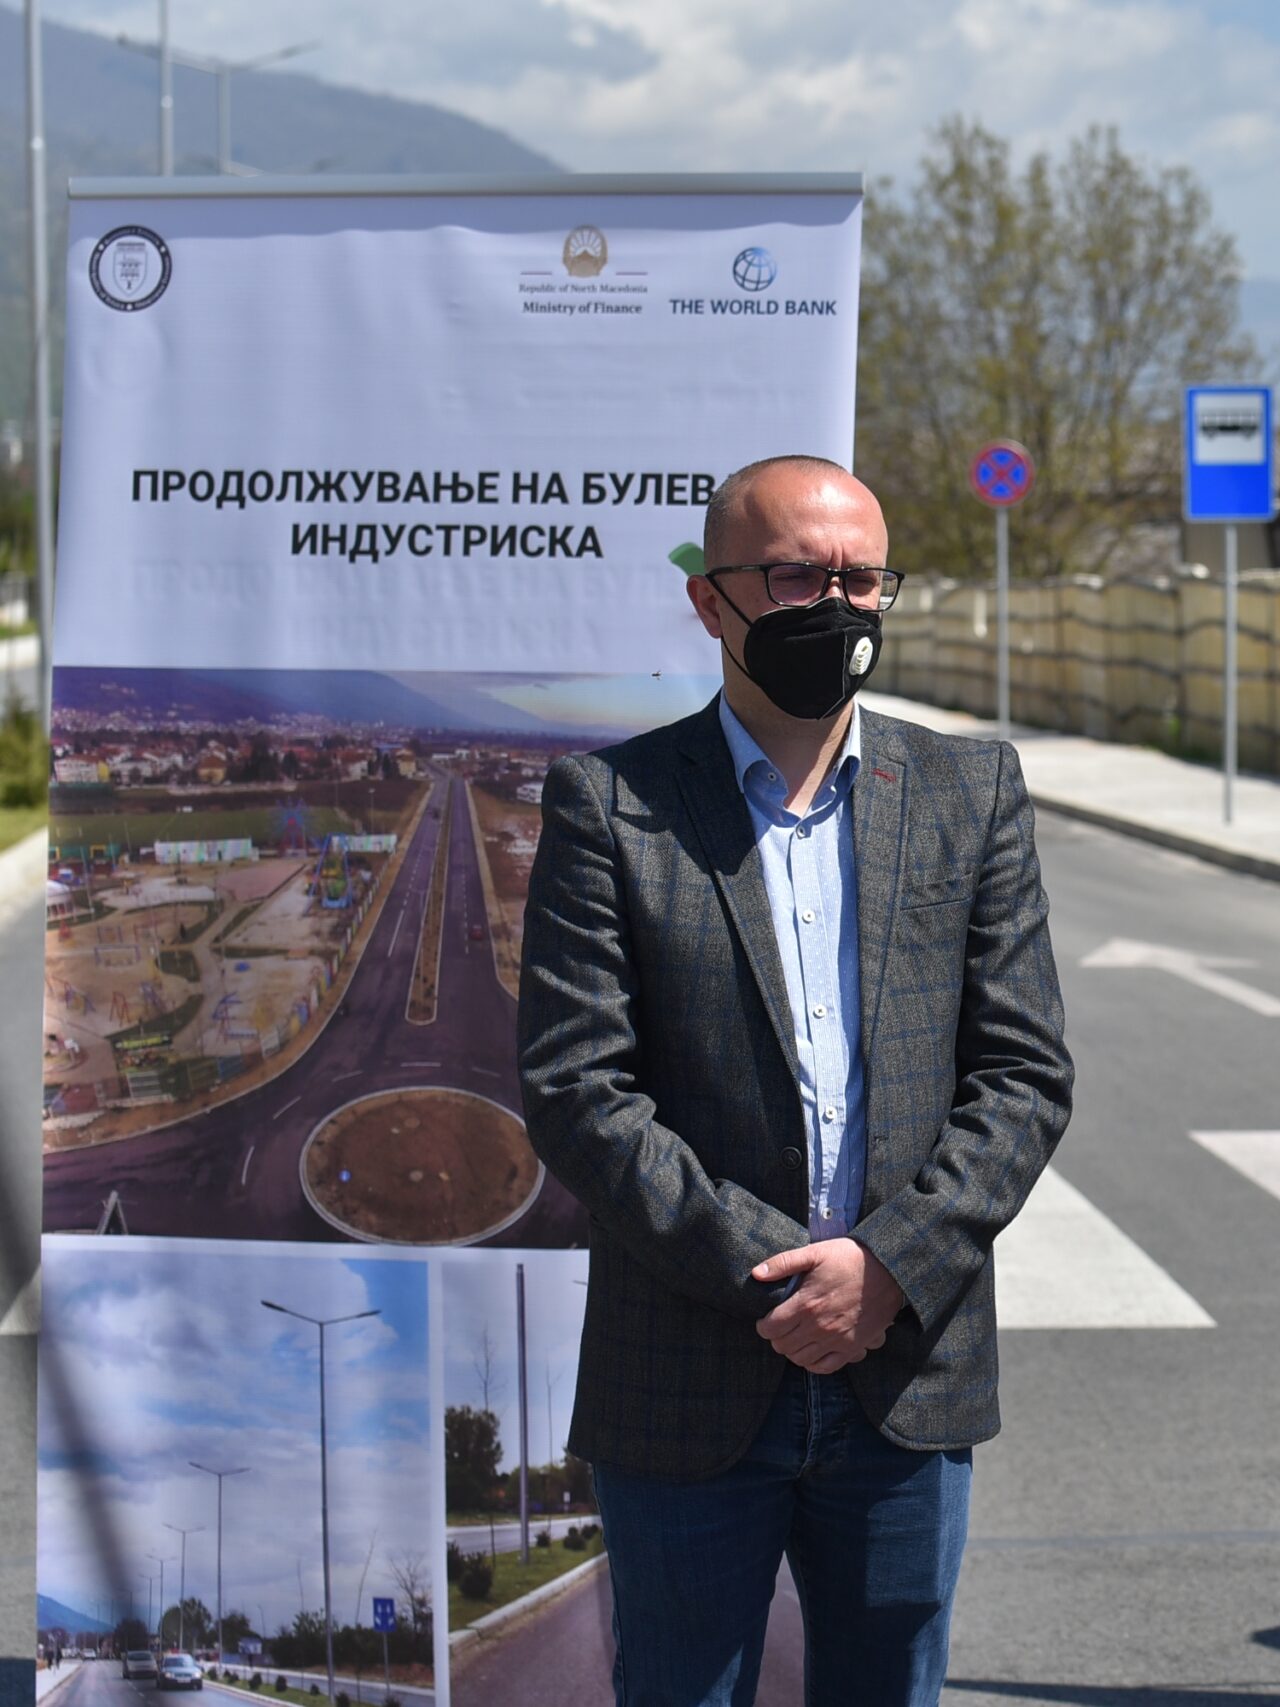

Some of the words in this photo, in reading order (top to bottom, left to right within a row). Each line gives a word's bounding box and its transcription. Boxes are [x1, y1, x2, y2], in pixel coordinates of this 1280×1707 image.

[571, 284, 598, 293] North
[600, 284, 647, 293] Macedonia
[523, 302, 575, 316] Ministry
[578, 302, 592, 313] of
[594, 302, 642, 314] Finance
[669, 299, 704, 315] THE
[710, 299, 779, 315] WORLD
[785, 300, 837, 315] BANK
[131, 470, 500, 510] ПРОДОЛЖУВАЊЕ
[511, 472, 570, 504] НА
[290, 523, 604, 563] ИНДУСТРИСКА
